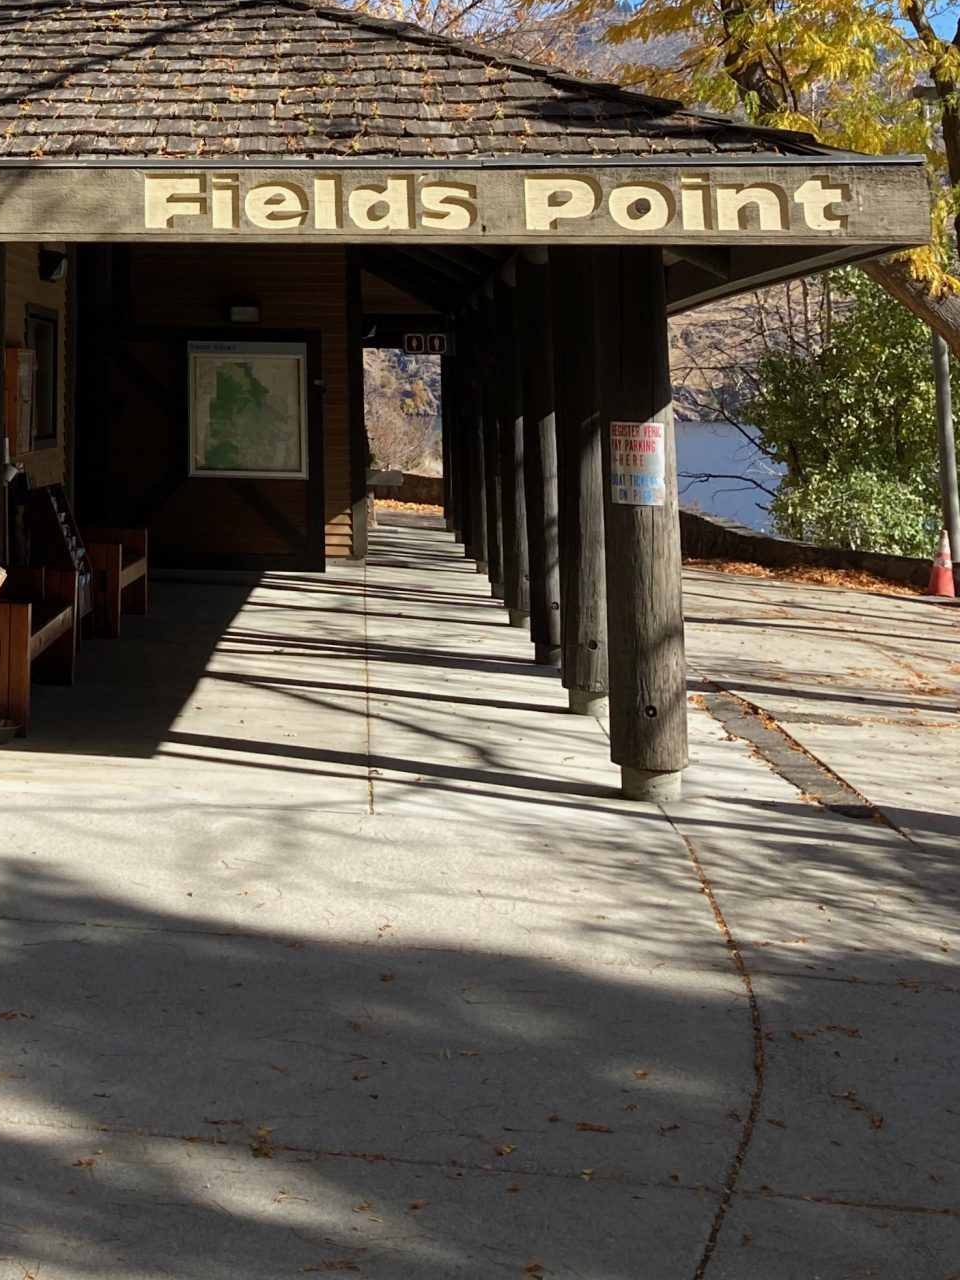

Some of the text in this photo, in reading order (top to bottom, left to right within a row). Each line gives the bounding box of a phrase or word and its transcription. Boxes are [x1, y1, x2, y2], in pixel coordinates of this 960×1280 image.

[144, 173, 853, 231] Fields Point
[625, 440, 656, 453] PARKING
[619, 454, 645, 467] HERE
